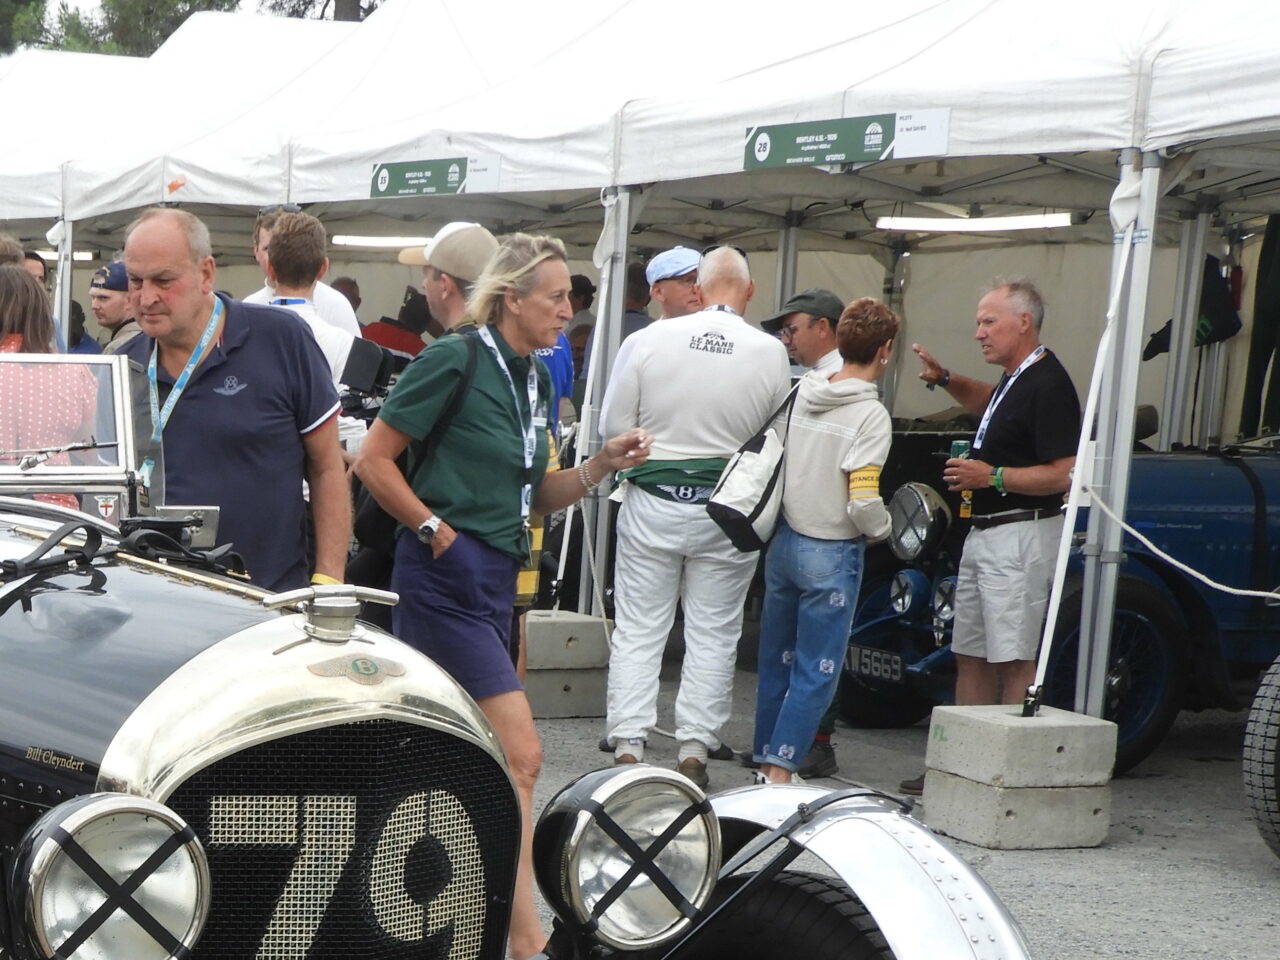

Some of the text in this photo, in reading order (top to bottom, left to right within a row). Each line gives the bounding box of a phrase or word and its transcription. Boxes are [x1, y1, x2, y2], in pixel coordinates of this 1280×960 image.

[757, 142, 768, 153] 28
[691, 336, 735, 348] LE MANS
[689, 342, 733, 355] CLASSIC
[25, 746, 85, 771] Bill Cleyndert
